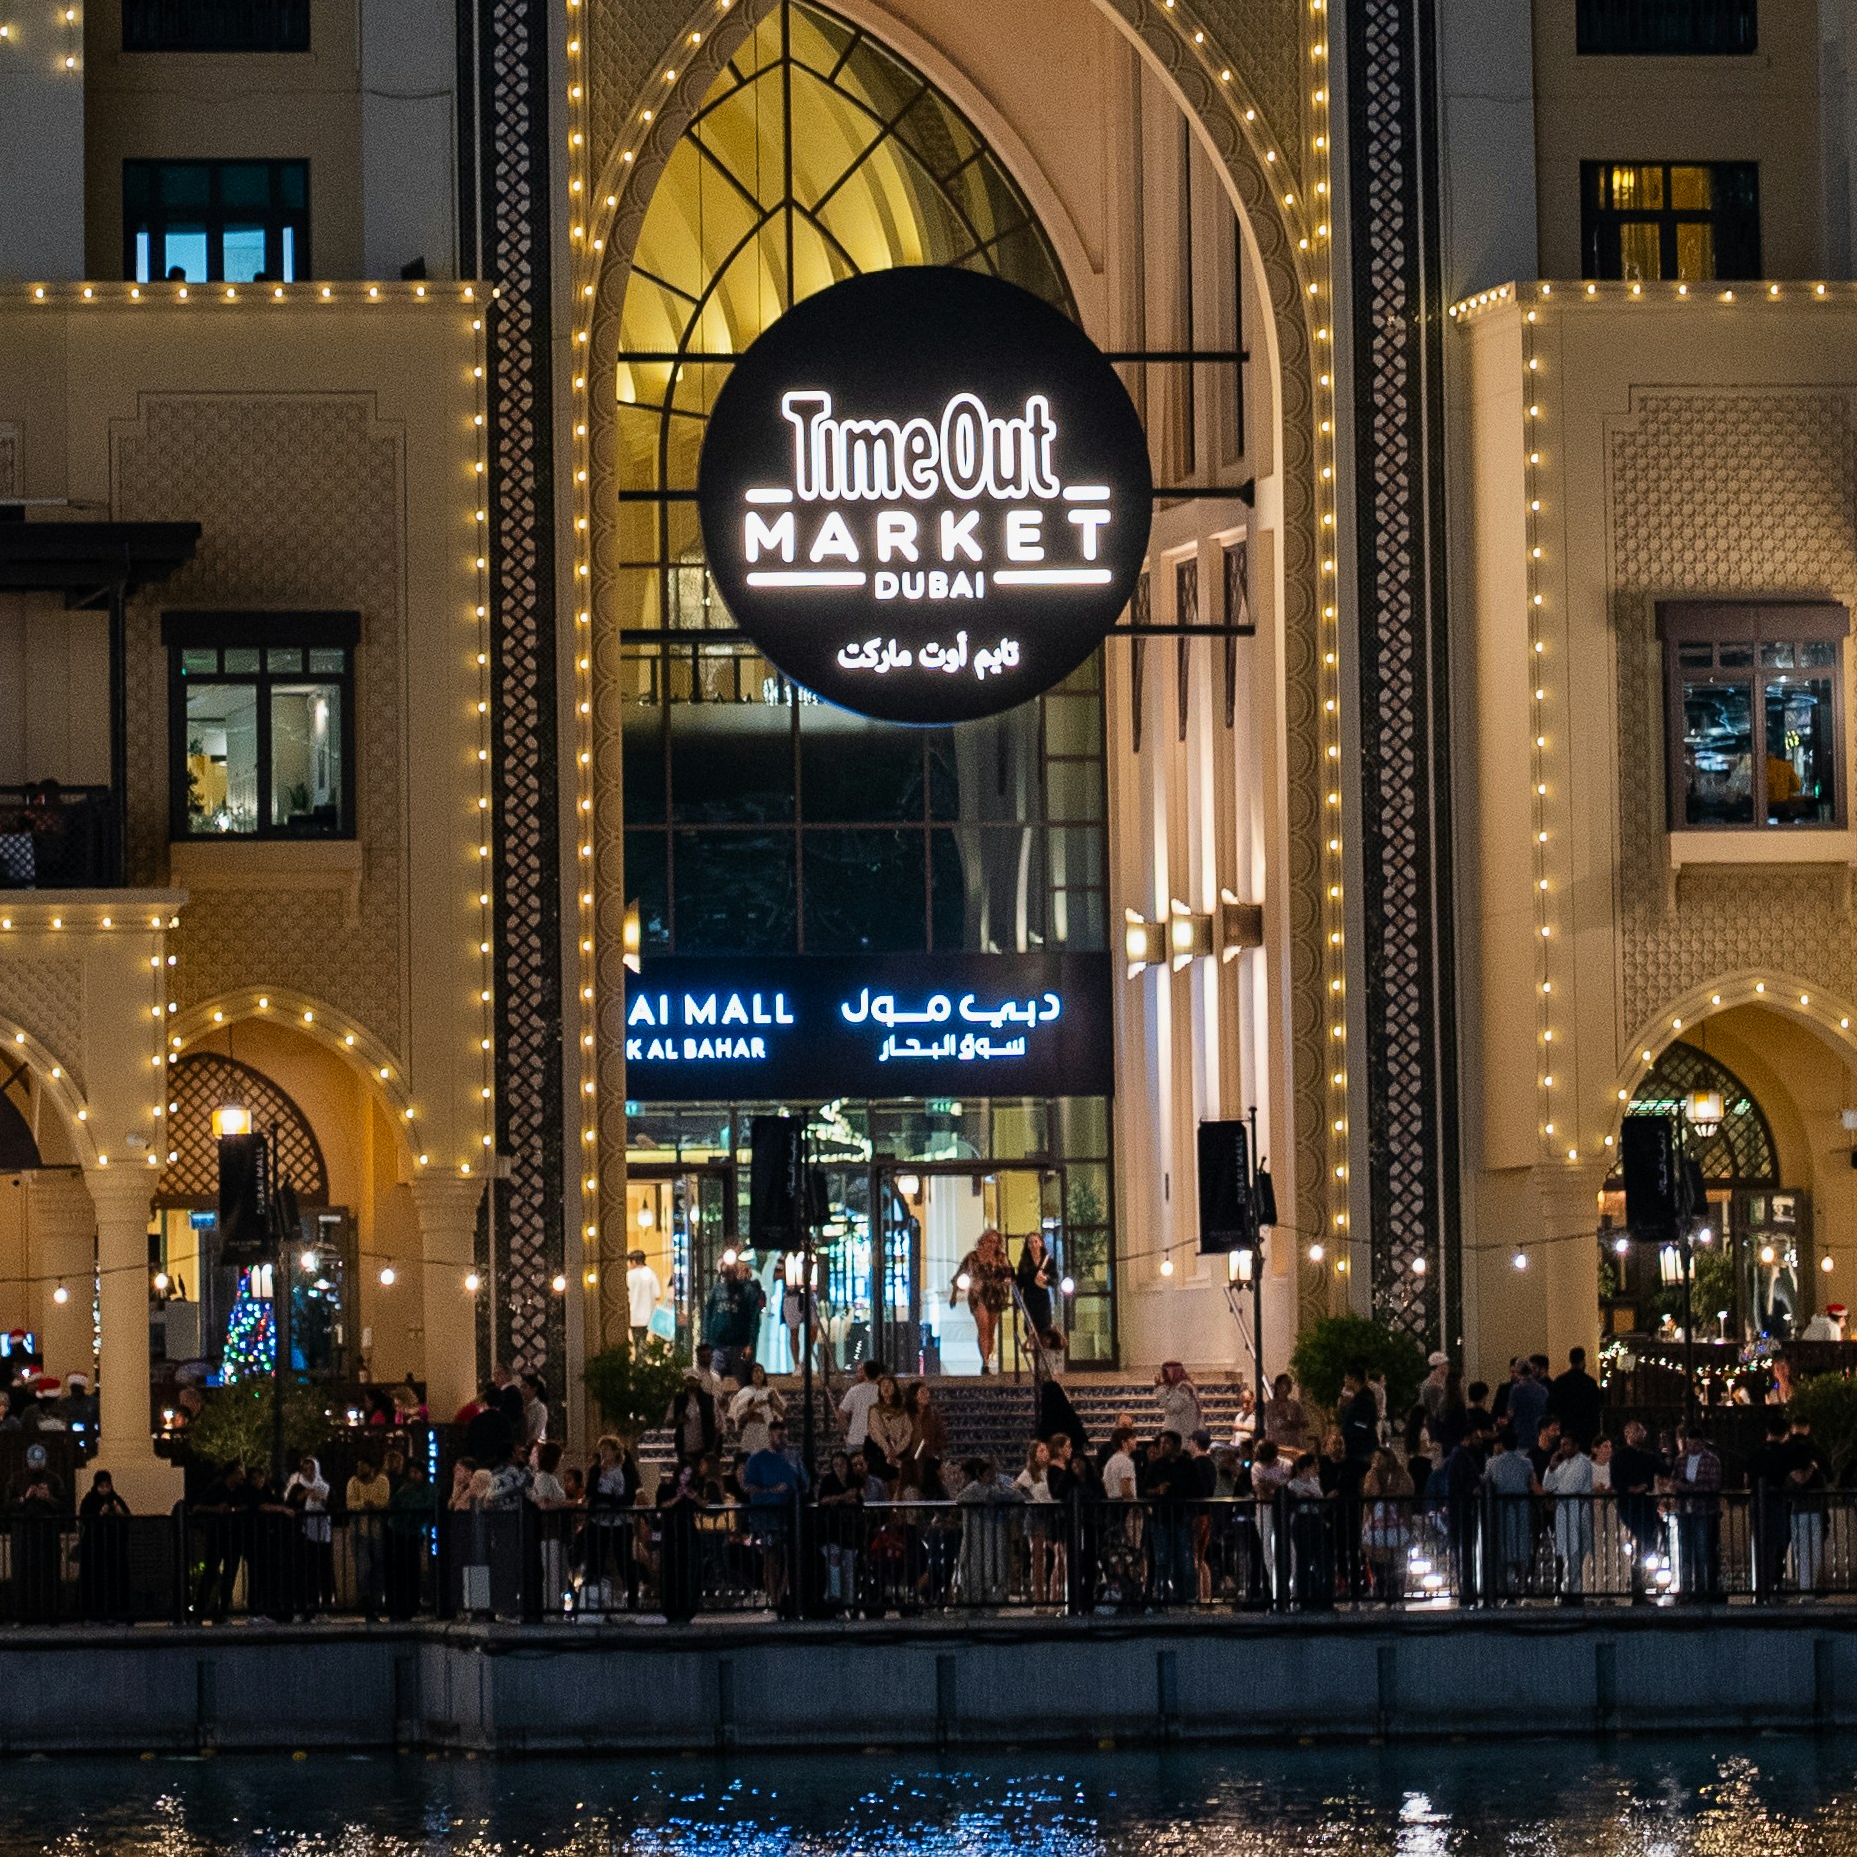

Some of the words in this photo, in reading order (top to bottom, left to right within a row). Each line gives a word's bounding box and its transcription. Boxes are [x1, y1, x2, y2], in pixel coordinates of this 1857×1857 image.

[744, 509, 1112, 563] MARKET
[874, 570, 985, 599] DUBAI
[837, 637, 912, 673] ماركت
[973, 637, 1021, 680] تايم
[627, 993, 669, 1025] AI
[684, 993, 793, 1025] MALL
[841, 987, 952, 1028] مول
[959, 993, 1060, 1028] دبي
[647, 1038, 679, 1060] AL
[683, 1036, 766, 1060] BAHAR
